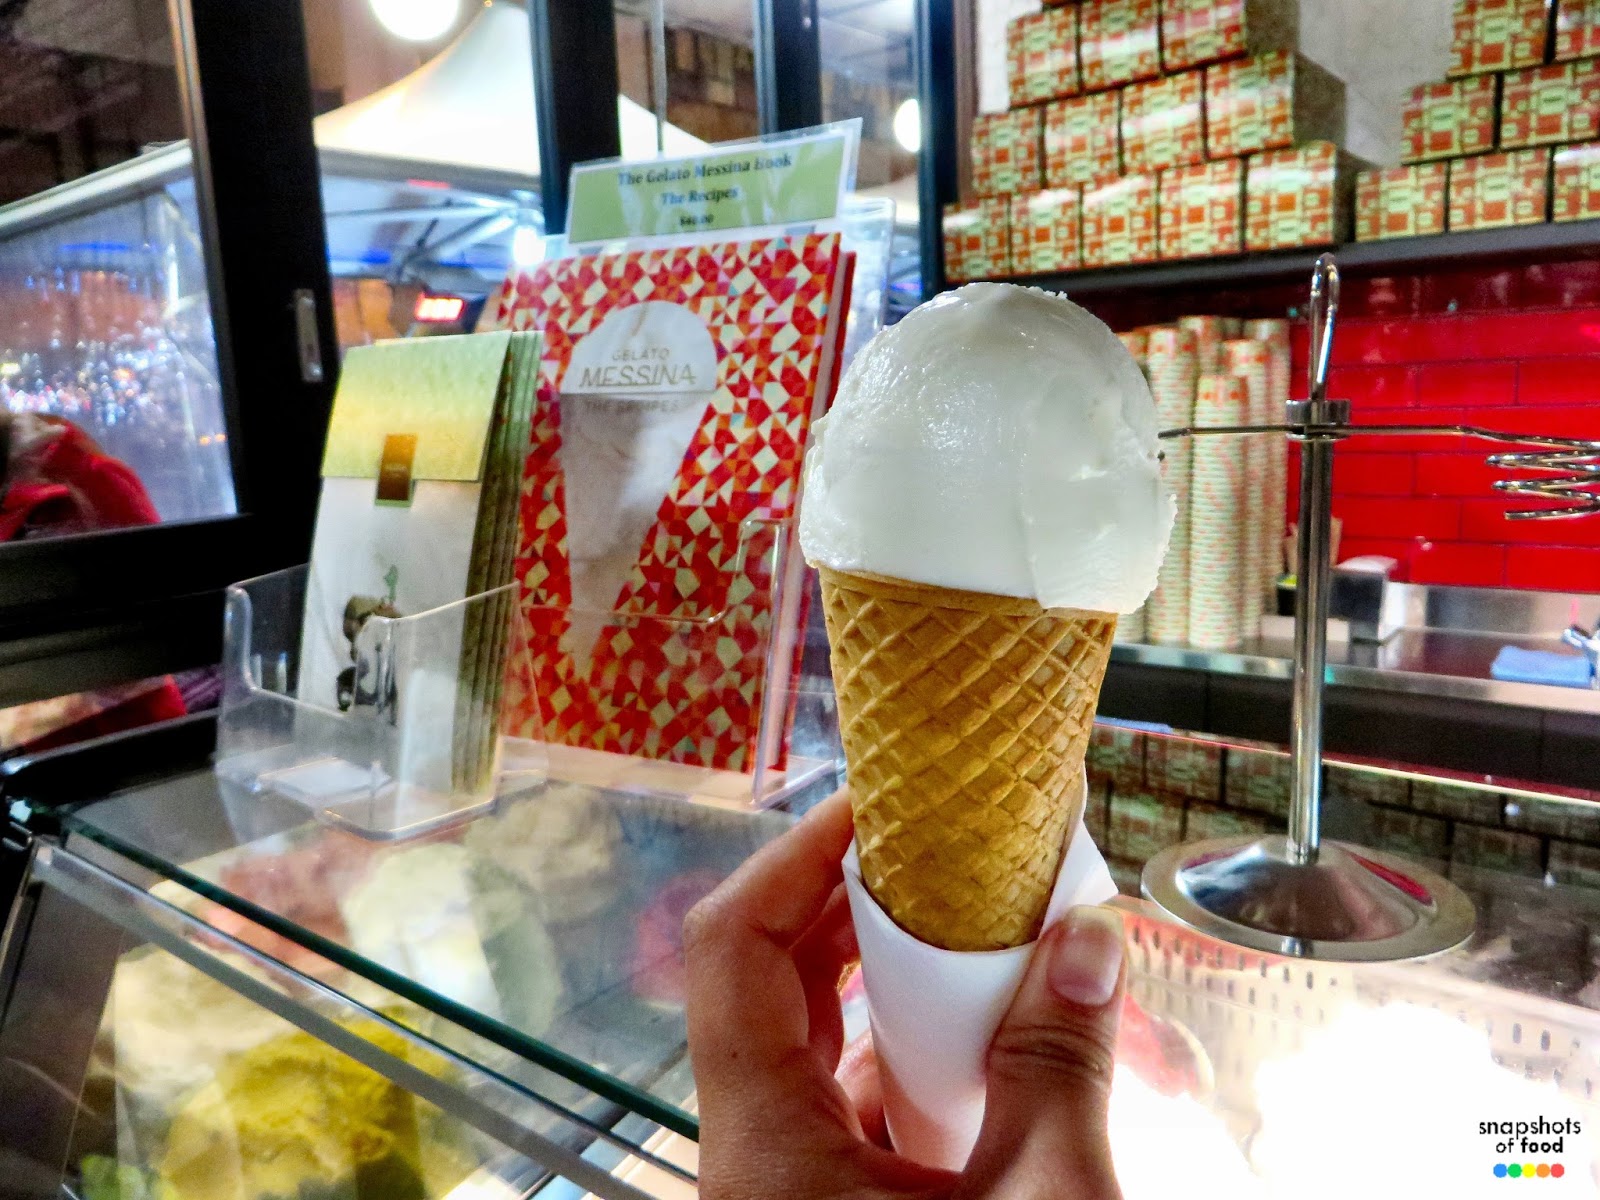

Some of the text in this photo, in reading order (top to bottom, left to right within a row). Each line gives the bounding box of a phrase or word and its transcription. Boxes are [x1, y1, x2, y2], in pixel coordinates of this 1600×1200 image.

[618, 153, 790, 184] The Gelato Messina Book
[661, 187, 738, 205] The Recipes
[612, 348, 670, 361] GELATO
[579, 364, 697, 387] MESSINA
